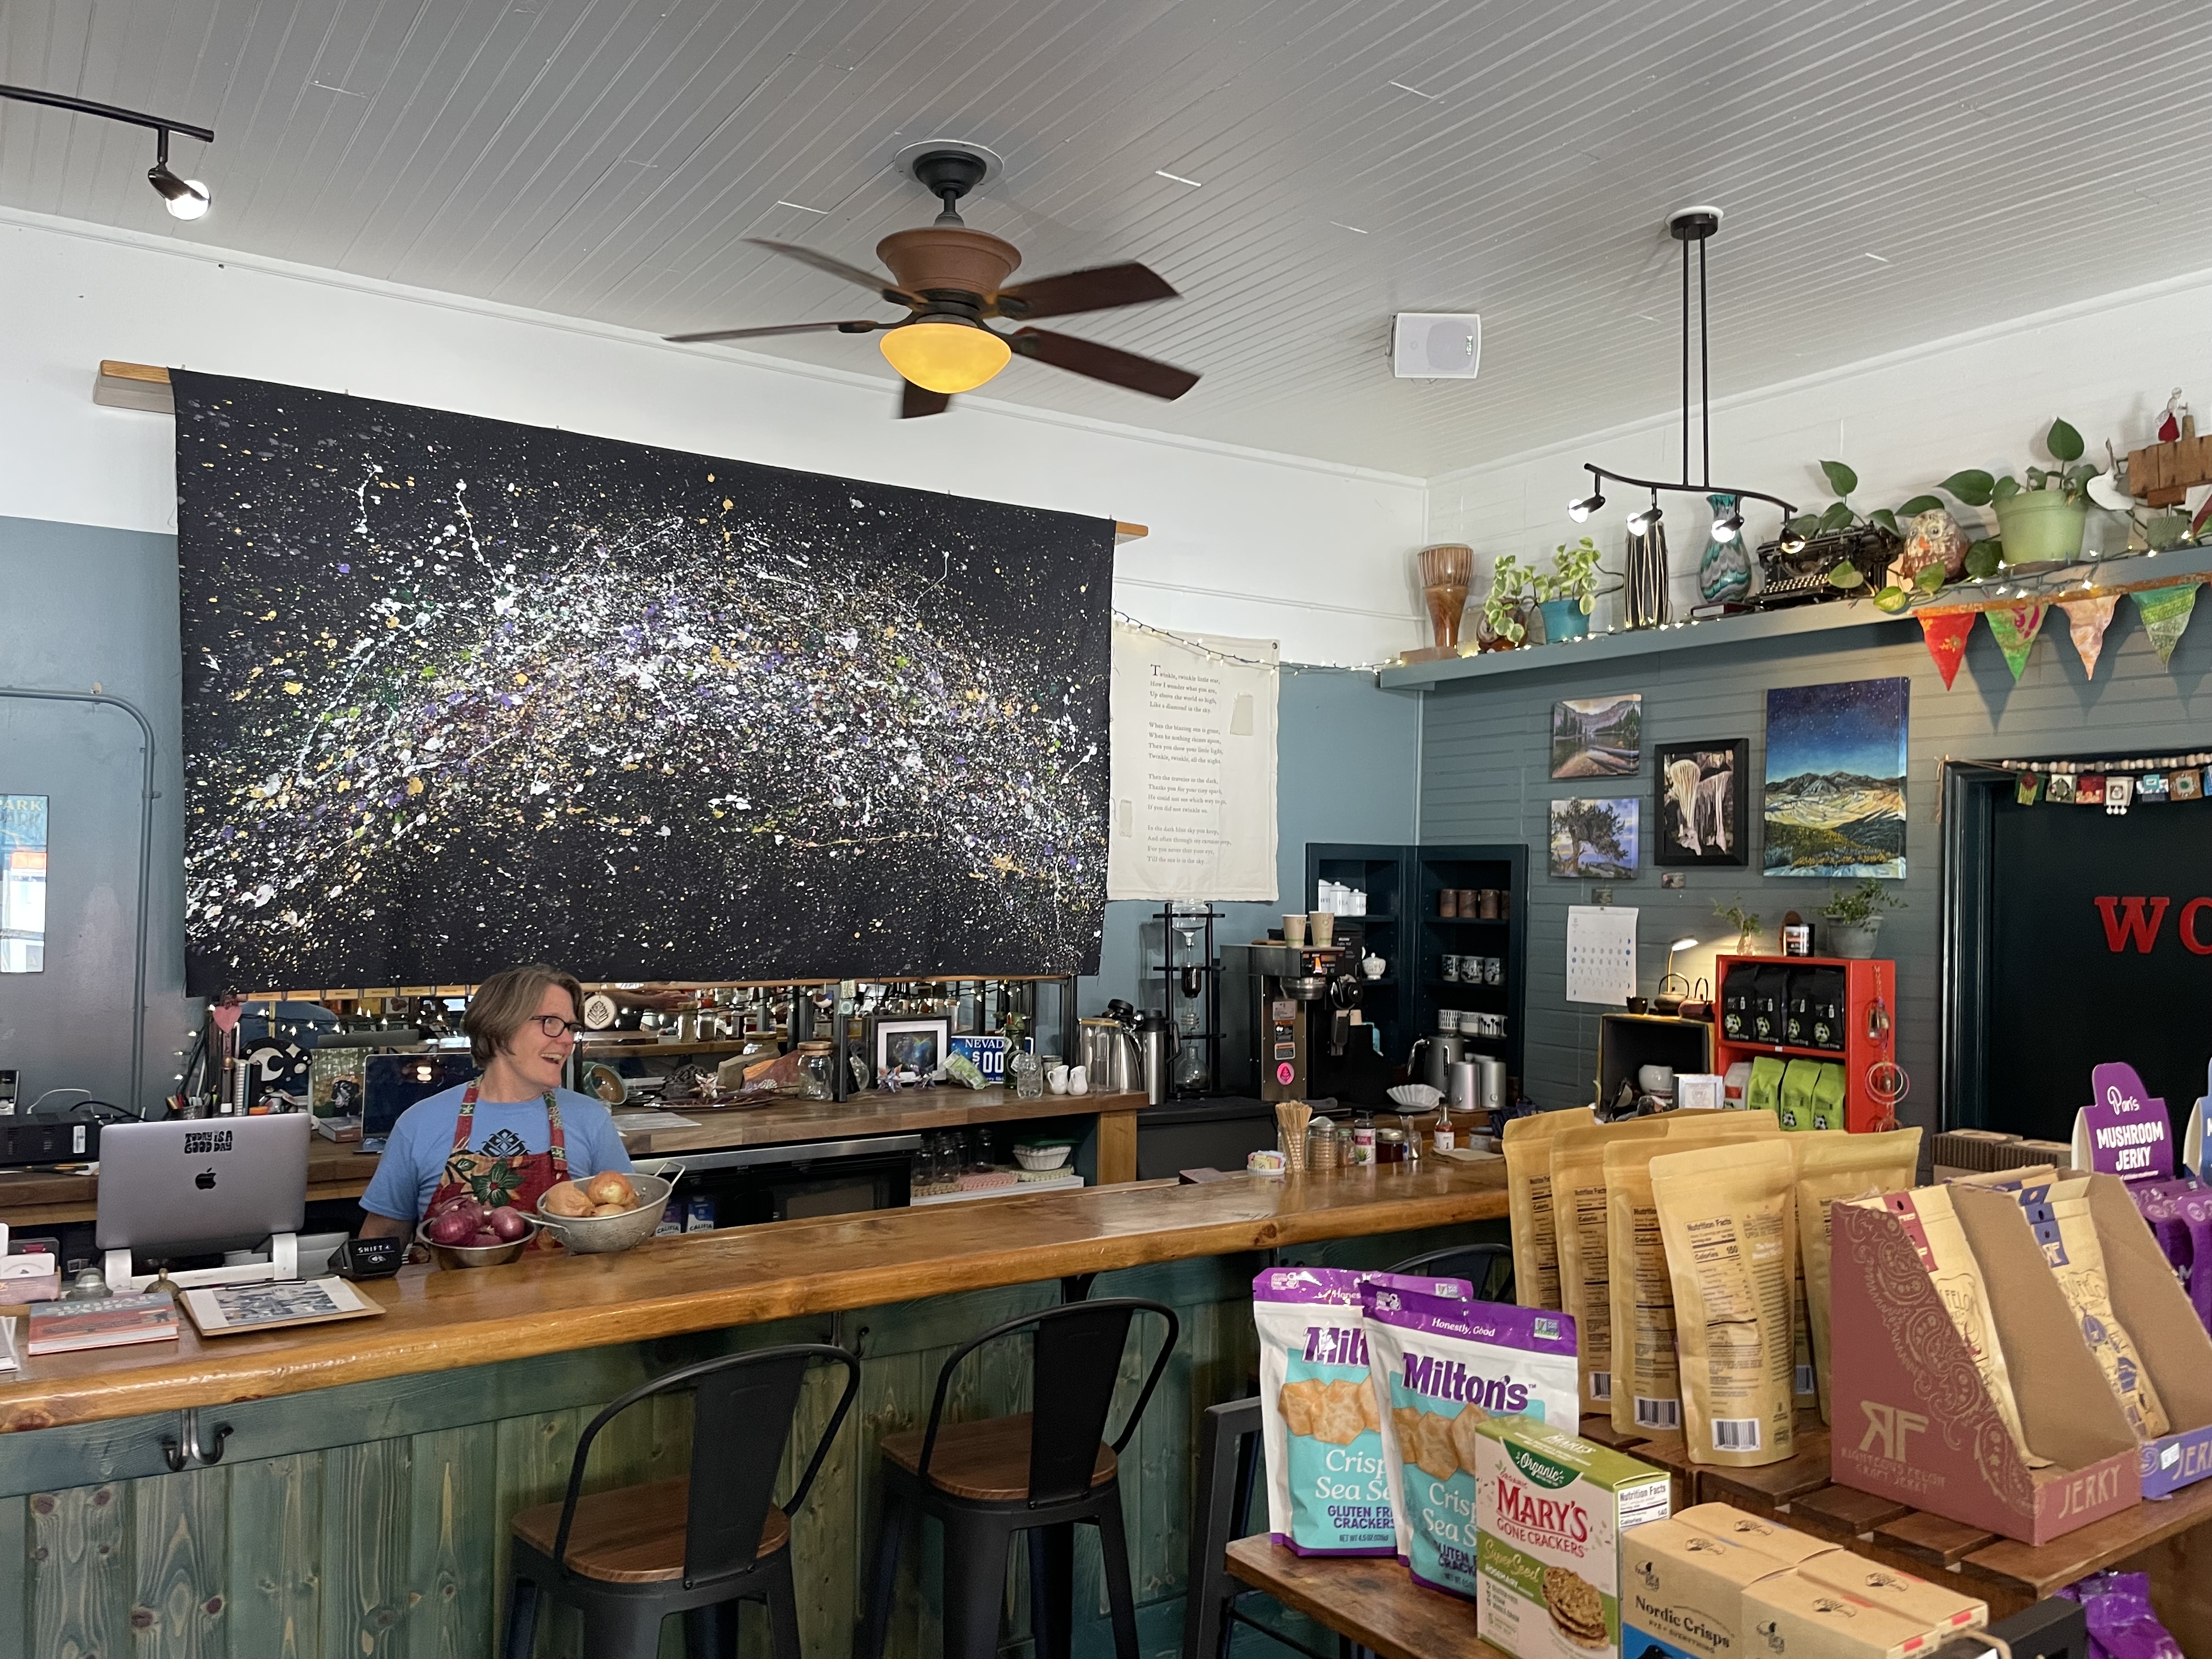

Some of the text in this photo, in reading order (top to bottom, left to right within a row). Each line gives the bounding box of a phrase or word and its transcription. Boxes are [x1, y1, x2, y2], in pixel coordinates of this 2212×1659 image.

[184, 1141, 232, 1154] GOOD DAY
[185, 1131, 213, 1144] TODAY
[2096, 1121, 2164, 1149] MUSHROOM
[2115, 1146, 2151, 1171] JERKY
[1431, 1317, 1496, 1337] Honestly, Good
[1401, 1352, 1528, 1413] Milton's
[1326, 1449, 1386, 1480] Crisp
[1520, 1452, 1560, 1482] Organic
[2172, 1442, 2212, 1480] JER
[1315, 1476, 1361, 1500] Sea
[1620, 1484, 1666, 1502] Nutrition Facts
[2058, 1465, 2121, 1519] JERKY
[1328, 1505, 1371, 1517] GLUTEN
[1497, 1475, 1588, 1543] MARY'S
[1423, 1508, 1459, 1542] Sea
[1497, 1517, 1526, 1542] GONE
[1527, 1531, 1584, 1558] CRACKERS
[1635, 1595, 1730, 1648] Nordic Crisps
